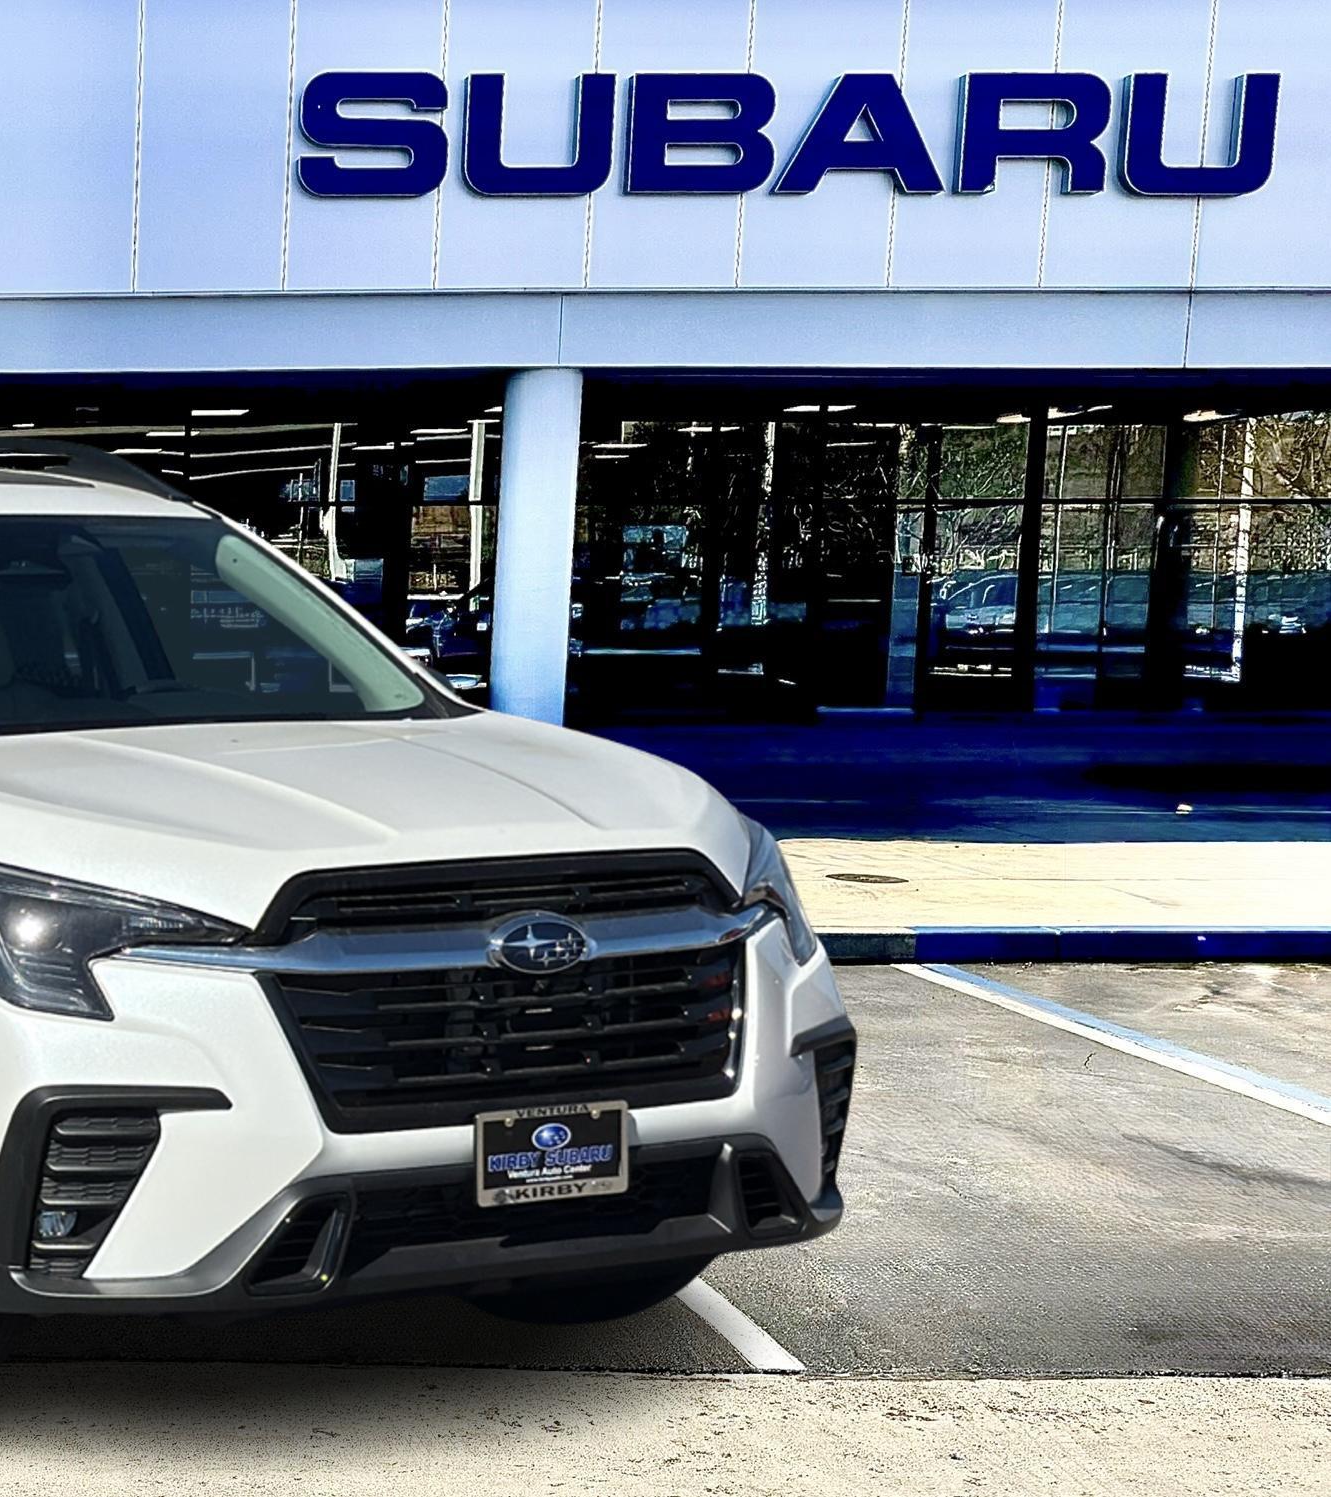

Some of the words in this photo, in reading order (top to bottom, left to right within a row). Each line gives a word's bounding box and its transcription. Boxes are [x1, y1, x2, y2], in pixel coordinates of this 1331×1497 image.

[297, 70, 1283, 197] SUBARU
[516, 1104, 589, 1118] VENTURA
[488, 1152, 541, 1172] KIRBY
[545, 1144, 613, 1166] SUBARU
[507, 1168, 541, 1180] Ventura
[541, 1166, 563, 1177] Auto
[563, 1164, 592, 1174] Center
[515, 1182, 588, 1200] KIRBY
